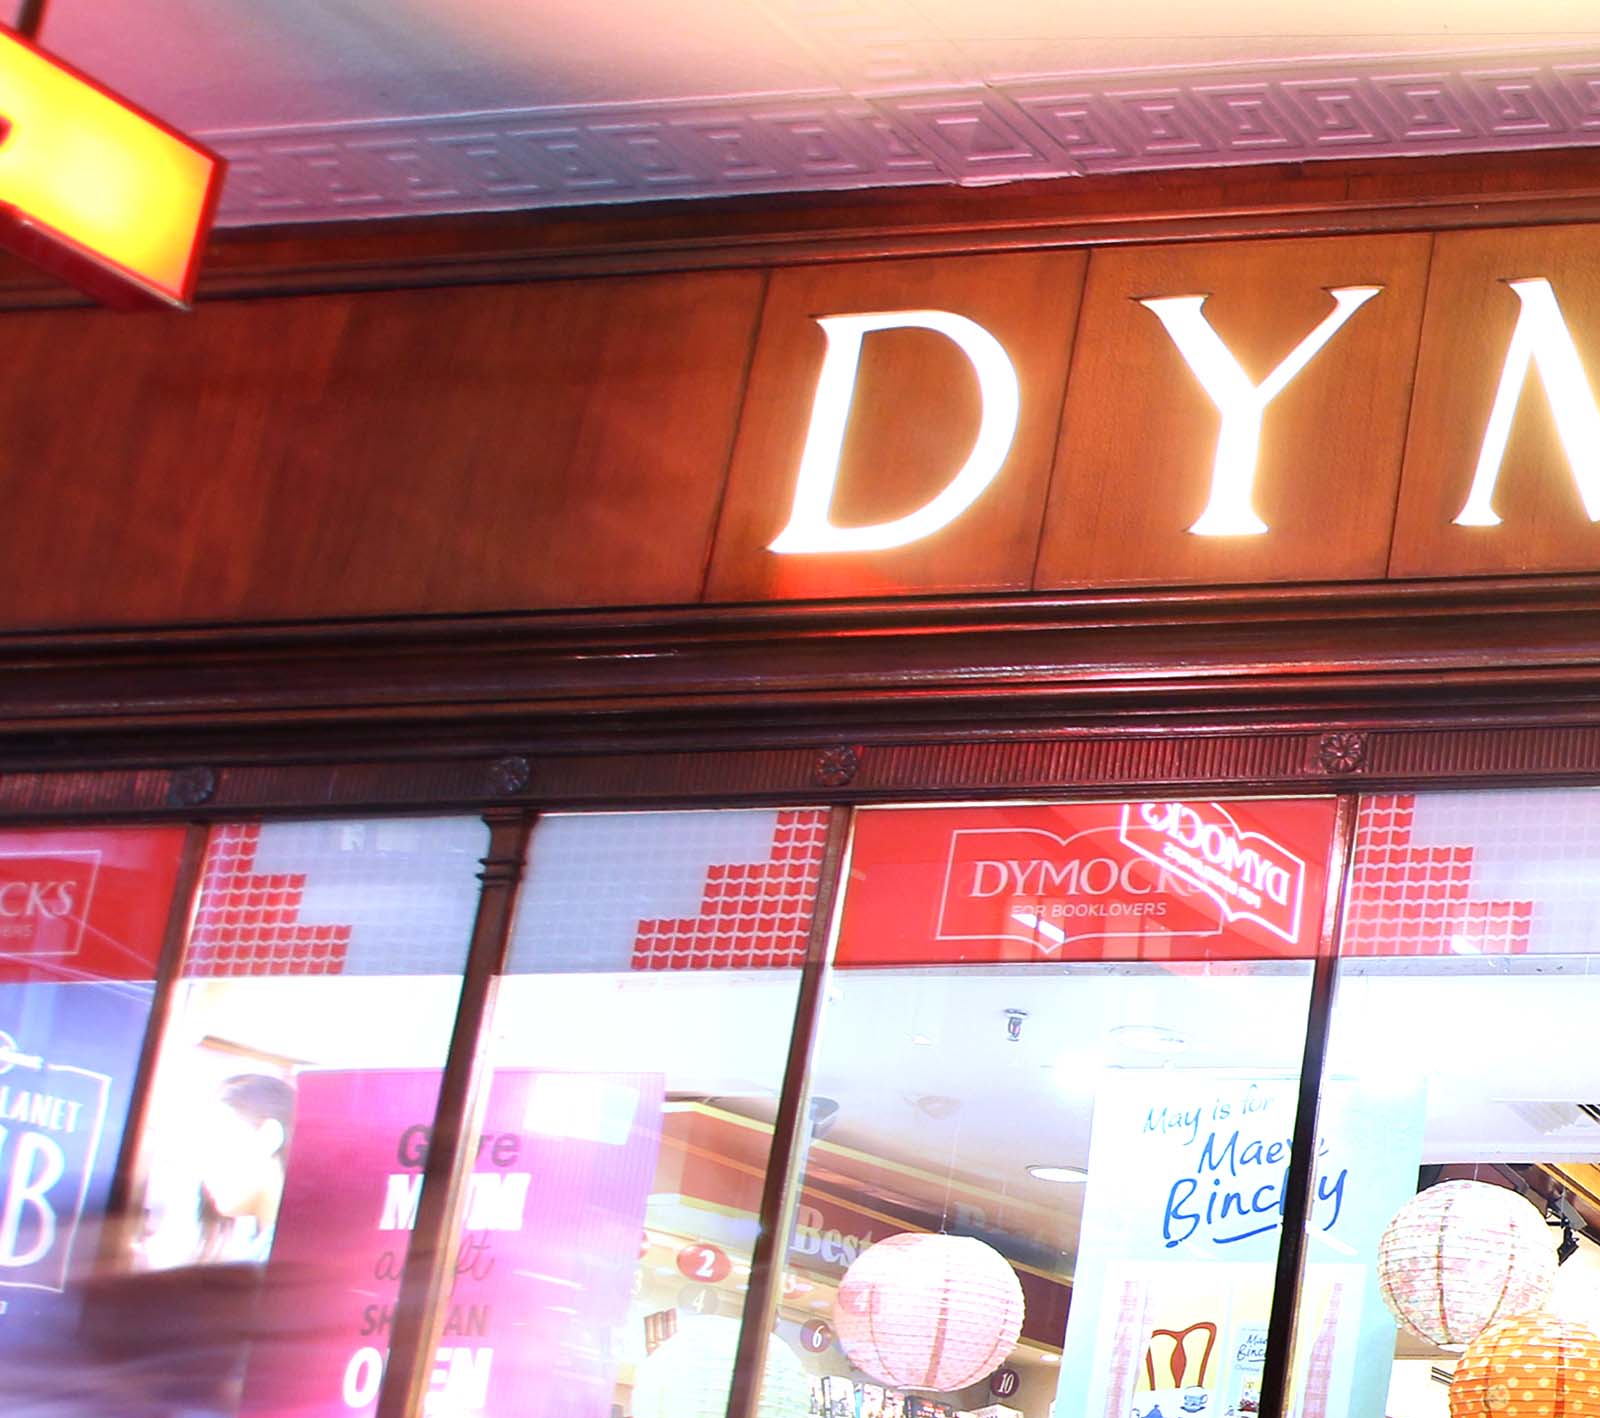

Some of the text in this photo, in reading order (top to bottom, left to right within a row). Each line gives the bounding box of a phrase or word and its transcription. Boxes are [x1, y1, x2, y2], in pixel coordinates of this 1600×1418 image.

[1012, 902, 1167, 917] FOR BOOKLOVERS
[1144, 1107, 1201, 1146] May
[698, 1249, 717, 1278] 2
[810, 1328, 824, 1349] 6
[997, 1373, 1015, 1395] 10
